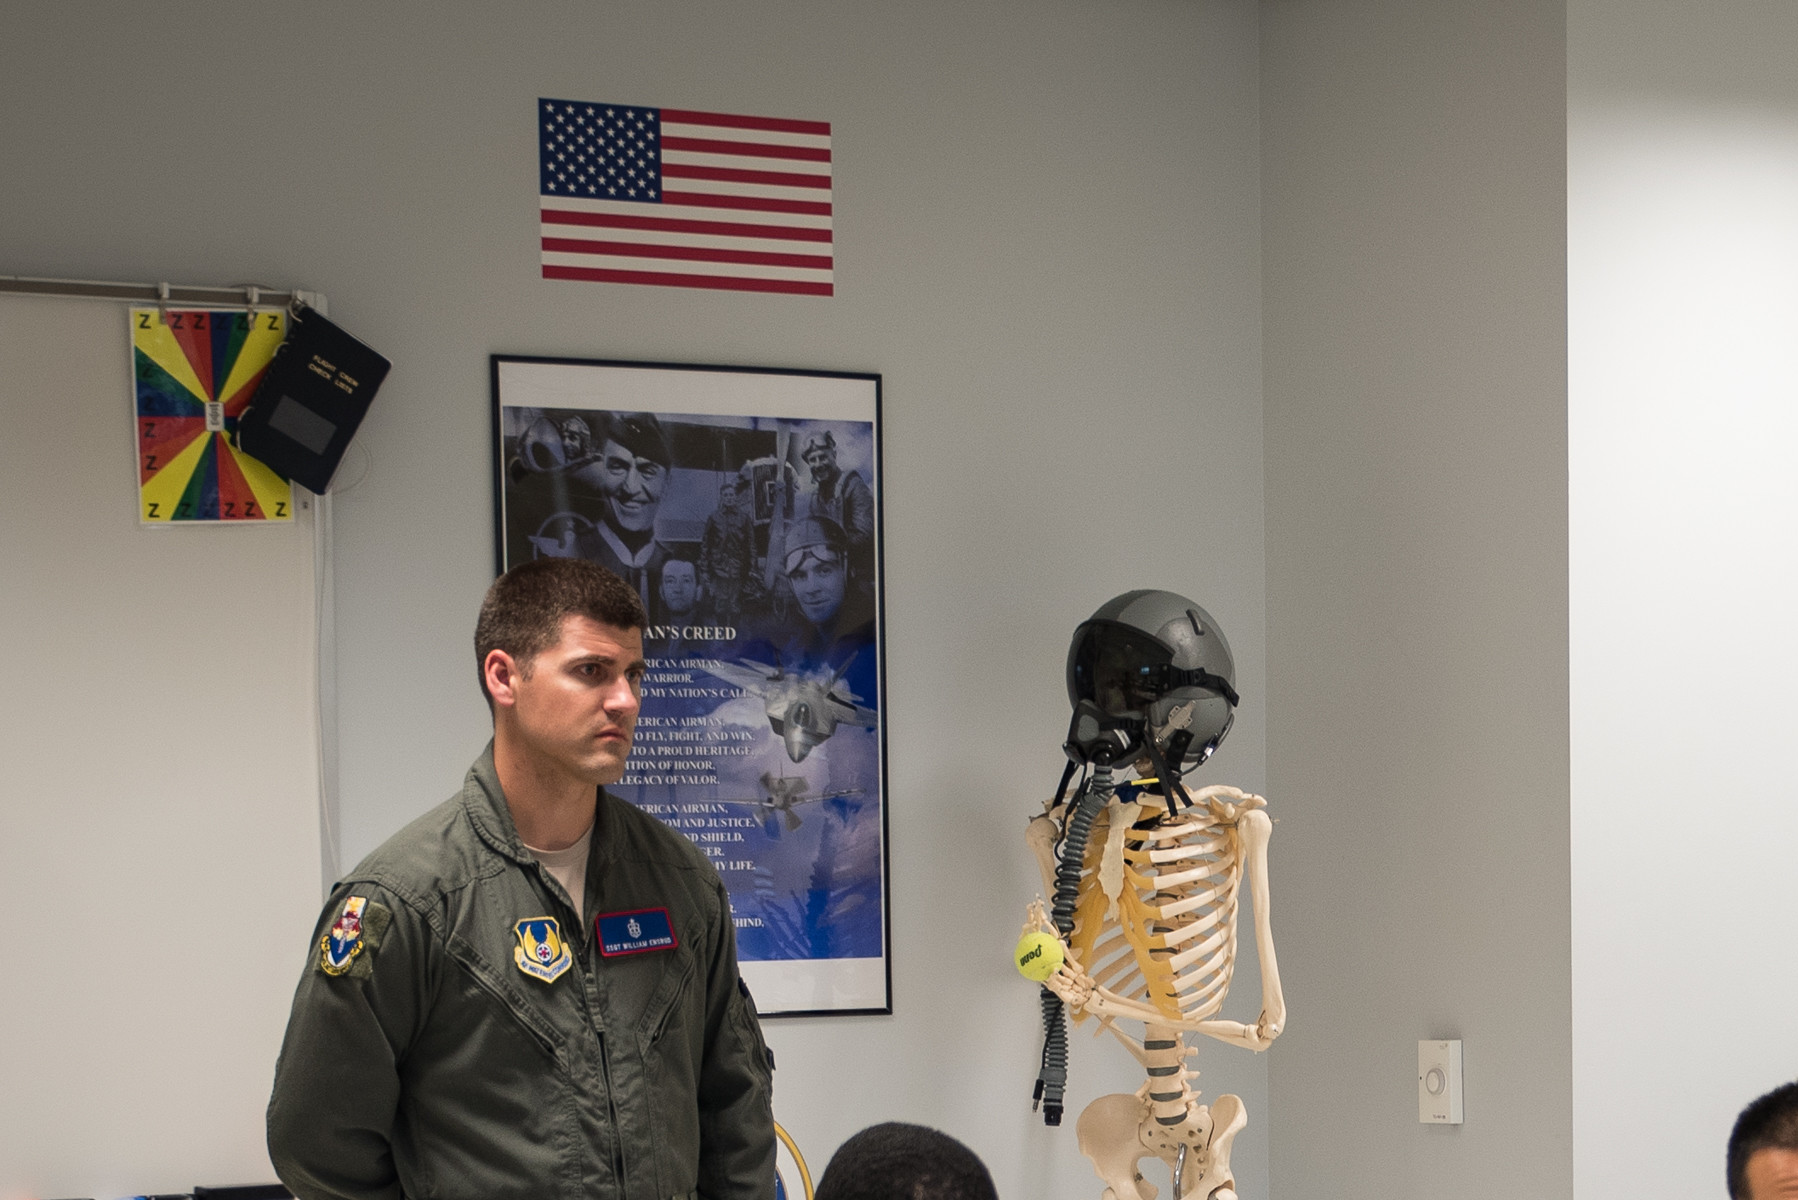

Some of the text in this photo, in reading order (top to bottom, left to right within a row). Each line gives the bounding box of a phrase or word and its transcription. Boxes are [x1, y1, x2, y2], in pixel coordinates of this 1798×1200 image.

[139, 314, 151, 329] Z
[173, 314, 184, 330] Z
[194, 314, 206, 330] Z
[268, 315, 280, 331] Z
[144, 422, 155, 438] Z
[146, 455, 157, 471] Z
[148, 503, 160, 518] Z
[225, 502, 236, 517] Z
[244, 502, 256, 517] Z
[276, 502, 287, 517] Z
[682, 625, 737, 640] CREED
[650, 688, 667, 698] MY
[635, 717, 677, 727] ERICAN
[645, 732, 667, 742] FLY,
[705, 732, 729, 741] AND
[632, 746, 646, 756] TO
[648, 746, 656, 756] A
[657, 746, 693, 756] PROUD
[658, 760, 672, 770] OF
[619, 775, 663, 785] LEGACY
[665, 775, 679, 785] OF
[681, 818, 705, 828] AND
[729, 860, 756, 871] LIFE.
